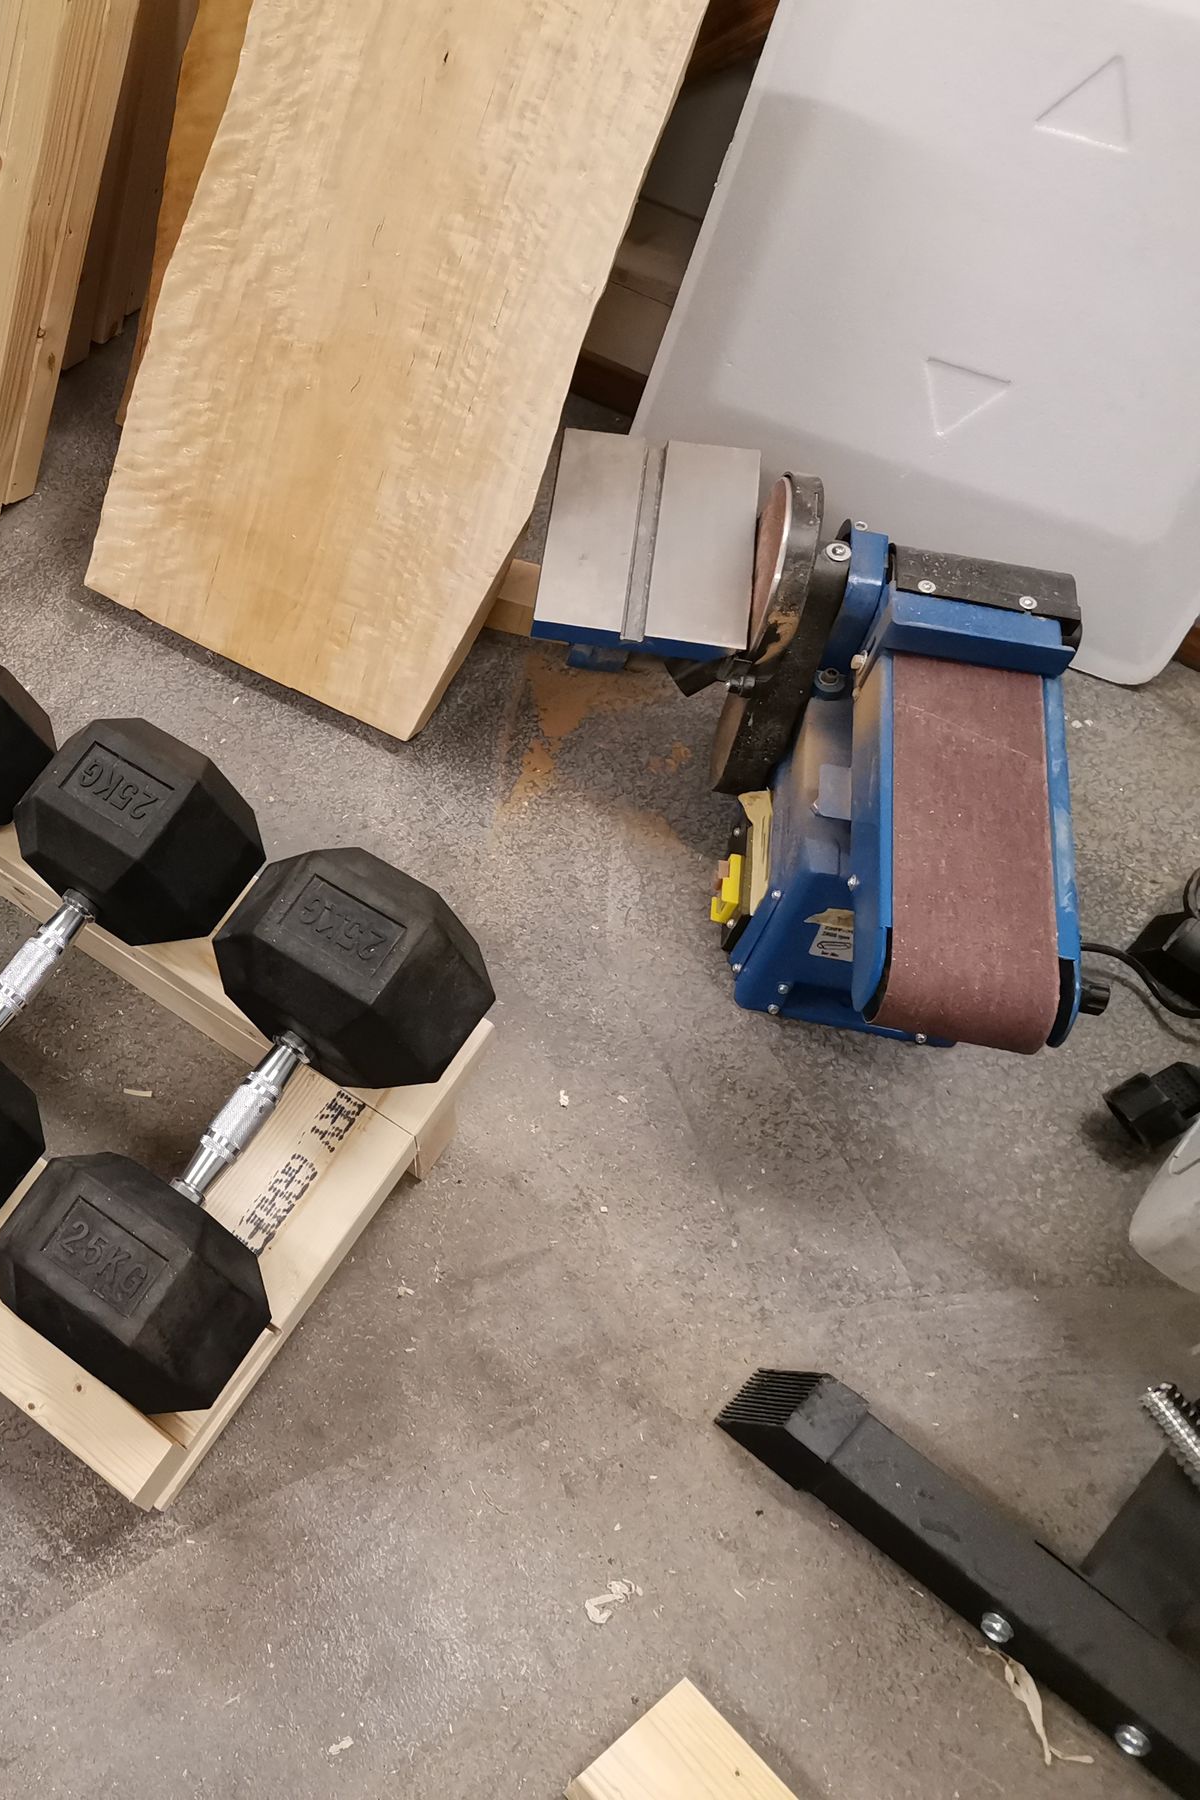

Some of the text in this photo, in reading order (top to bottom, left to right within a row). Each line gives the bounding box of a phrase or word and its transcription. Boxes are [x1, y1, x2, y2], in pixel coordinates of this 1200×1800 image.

[72, 758, 162, 821] 25KG
[297, 896, 391, 962] 25KG
[53, 1217, 149, 1297] 25KG
